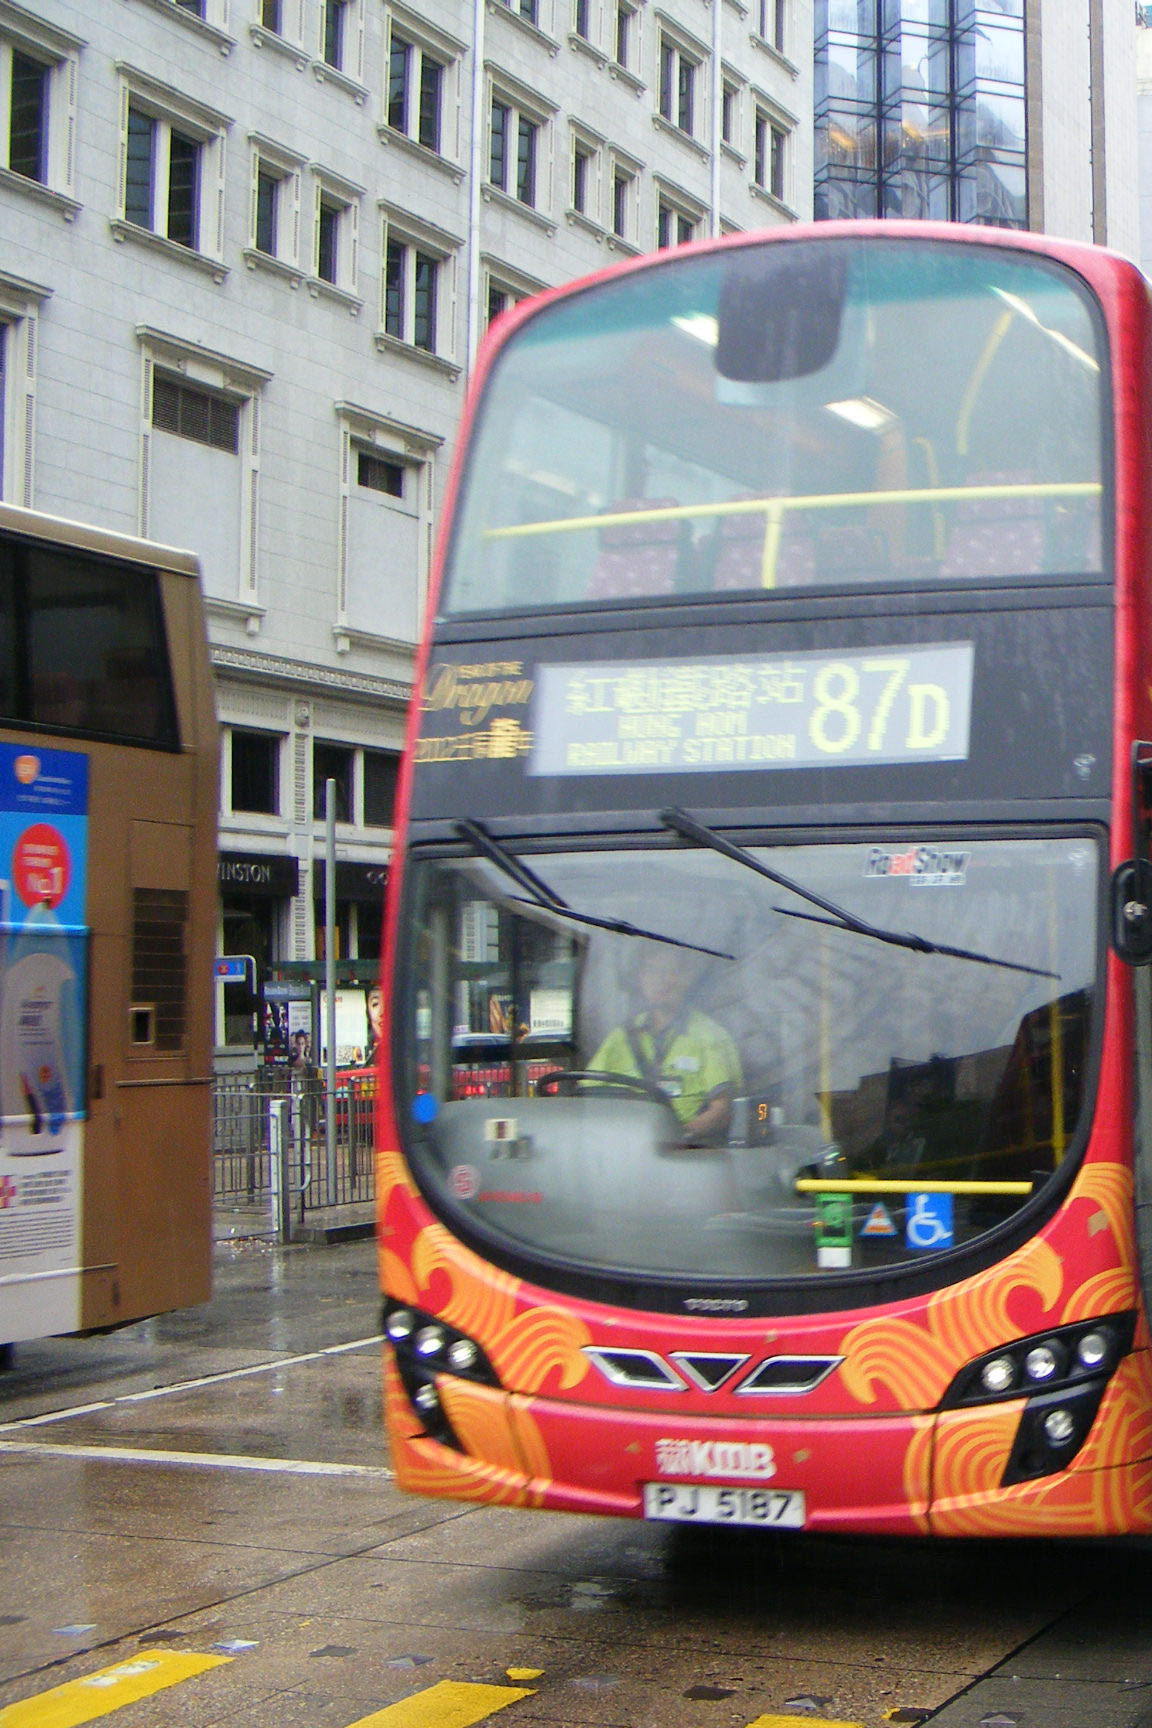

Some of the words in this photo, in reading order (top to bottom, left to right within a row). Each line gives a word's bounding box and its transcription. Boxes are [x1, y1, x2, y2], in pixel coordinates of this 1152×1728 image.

[809, 658, 951, 755] 87D
[682, 734, 797, 765] STATION
[217, 862, 271, 883] INSTON
[690, 1441, 777, 1479] KMB
[655, 1486, 700, 1516] PJ
[717, 1490, 793, 1520] 5187
